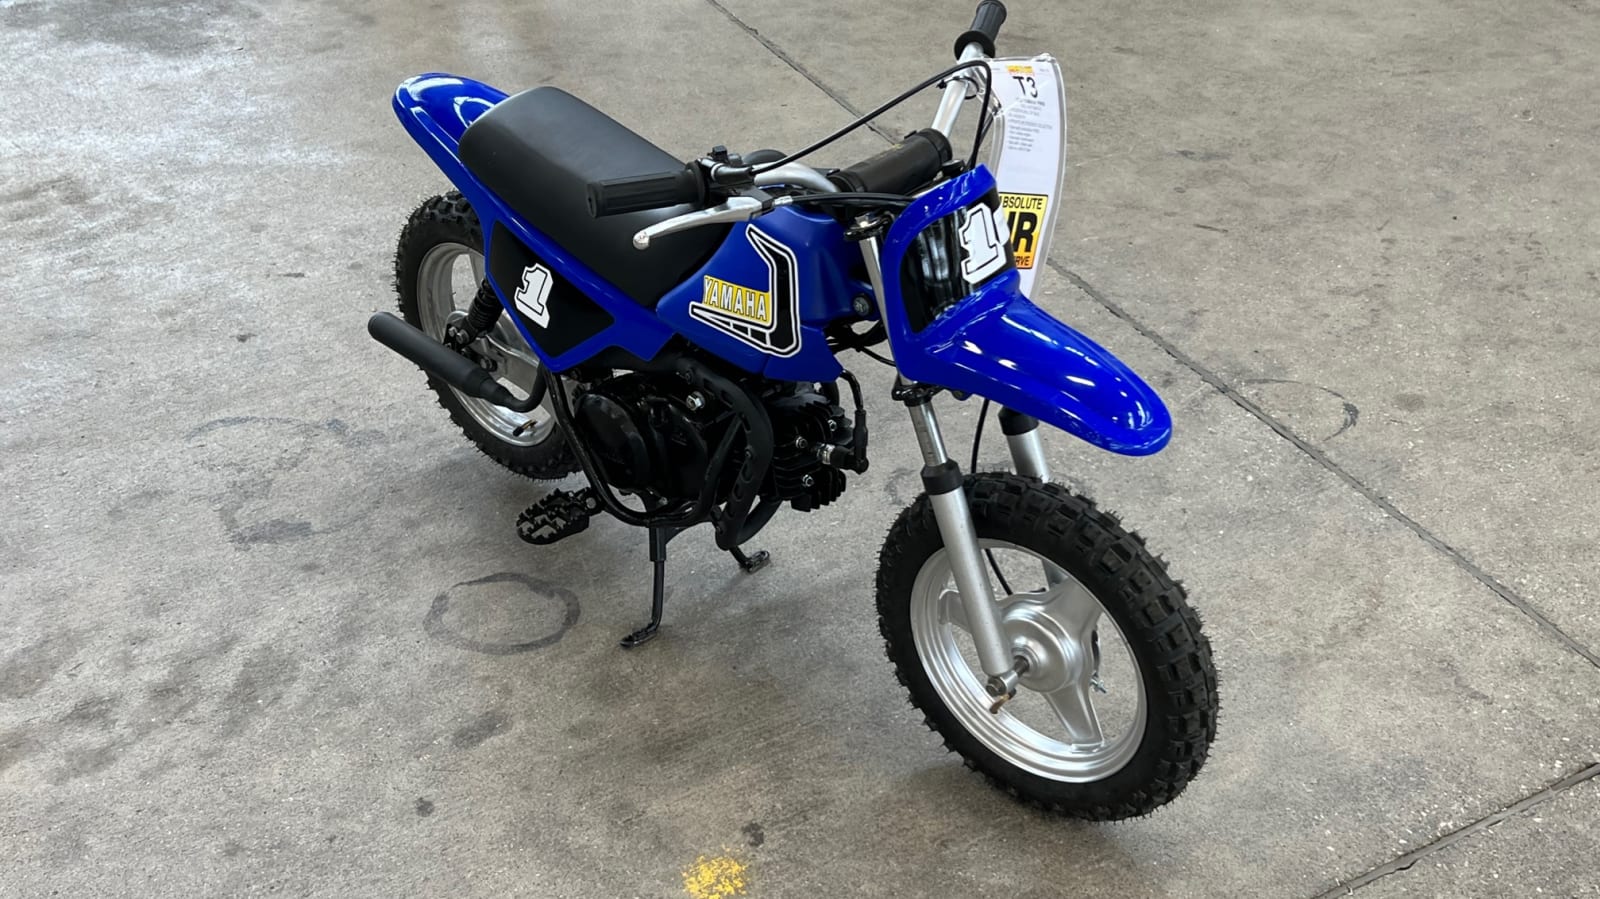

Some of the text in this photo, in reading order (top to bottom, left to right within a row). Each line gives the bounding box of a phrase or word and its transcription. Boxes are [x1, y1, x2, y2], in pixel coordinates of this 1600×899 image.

[1012, 75, 1038, 98] T3
[999, 195, 1043, 210] BSOLUTE
[515, 264, 552, 326] 1
[703, 276, 767, 321] YAMAHA
